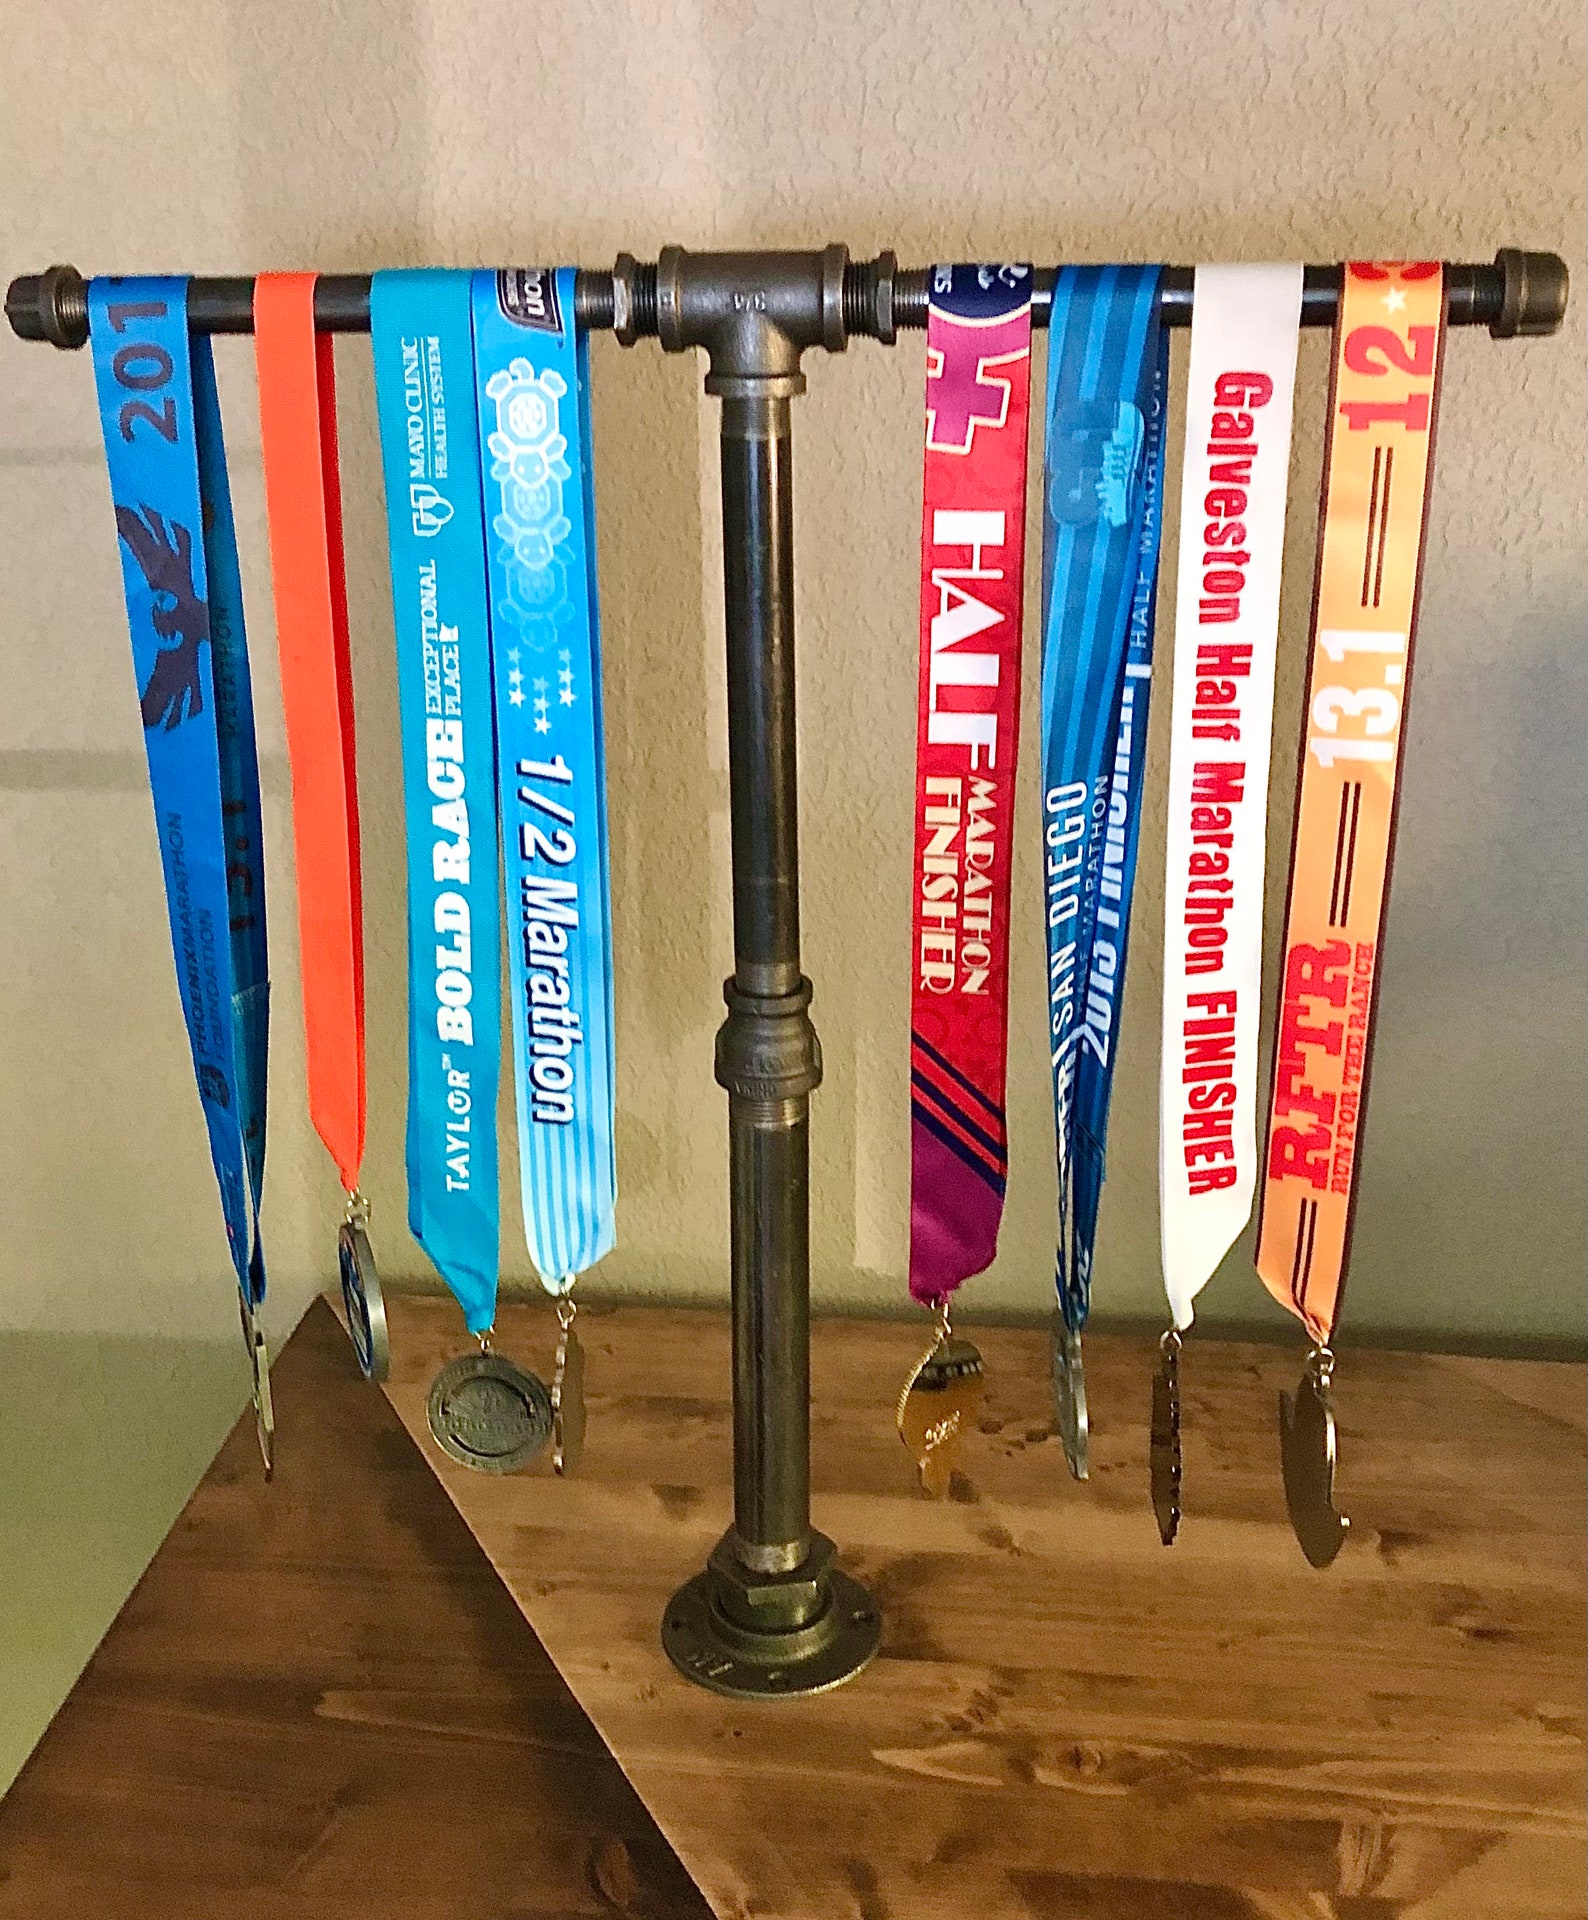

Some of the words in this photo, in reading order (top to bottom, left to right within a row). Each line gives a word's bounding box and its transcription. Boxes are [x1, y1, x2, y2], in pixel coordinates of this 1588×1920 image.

[401, 337, 421, 413] CLINIC
[406, 416, 426, 479] MAYO
[431, 408, 449, 479] HEALTH
[1198, 370, 1274, 625] Galveston
[419, 558, 441, 715] EXCEPTIONAL
[440, 644, 463, 716] PLACE
[927, 509, 1006, 771] HALF
[1191, 642, 1254, 743] Half
[1310, 627, 1407, 769] 13.1
[426, 718, 472, 886] RACE
[516, 754, 579, 869] 1/2
[1045, 779, 1088, 930] DIEGO
[1183, 760, 1246, 976] Marathon
[920, 775, 963, 995] FINISHER
[434, 890, 475, 1048] BOLD
[522, 873, 584, 1127] Marathon
[1050, 941, 1078, 1036] SAN
[1181, 989, 1238, 1197] FINISHER
[1268, 937, 1352, 1192] RFTR
[1337, 1090, 1359, 1142] FOR
[1342, 1036, 1366, 1086] THE
[1331, 1144, 1353, 1195] RUN
